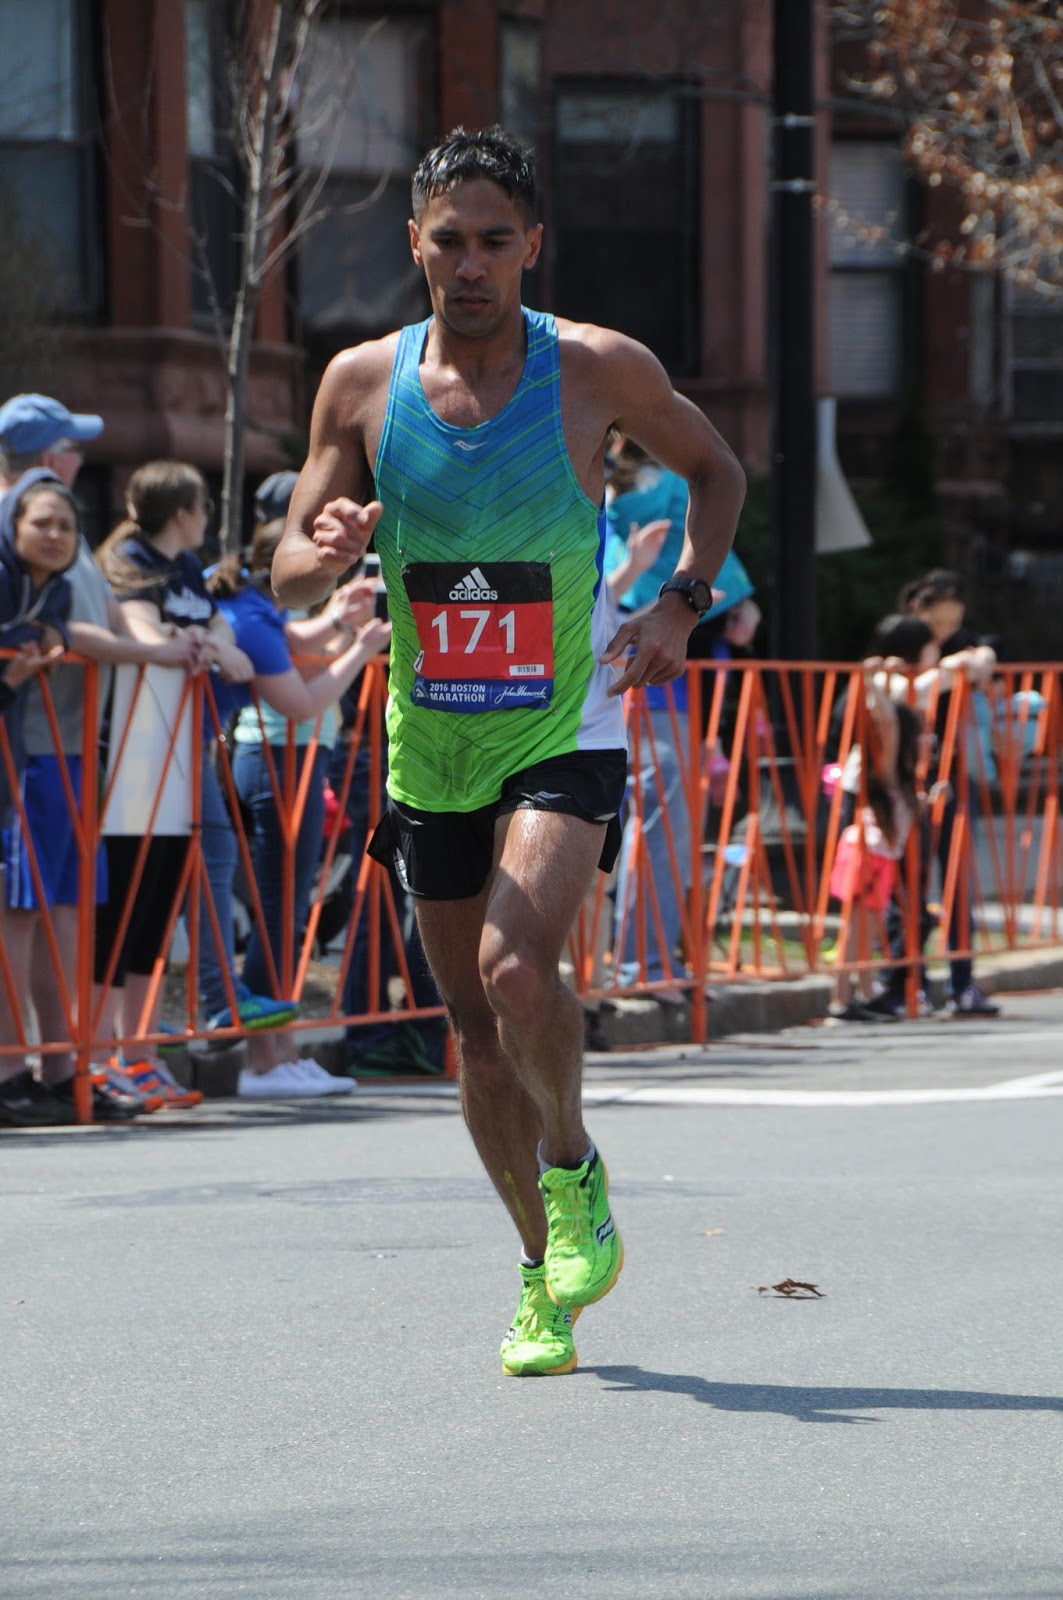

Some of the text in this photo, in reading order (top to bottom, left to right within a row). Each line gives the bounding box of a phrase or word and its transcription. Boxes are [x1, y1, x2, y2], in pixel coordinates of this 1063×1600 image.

[449, 588, 498, 600] adidas
[431, 610, 515, 654] 171
[430, 683, 485, 693] 2016 BOSTON
[430, 692, 485, 702] MARATHON
